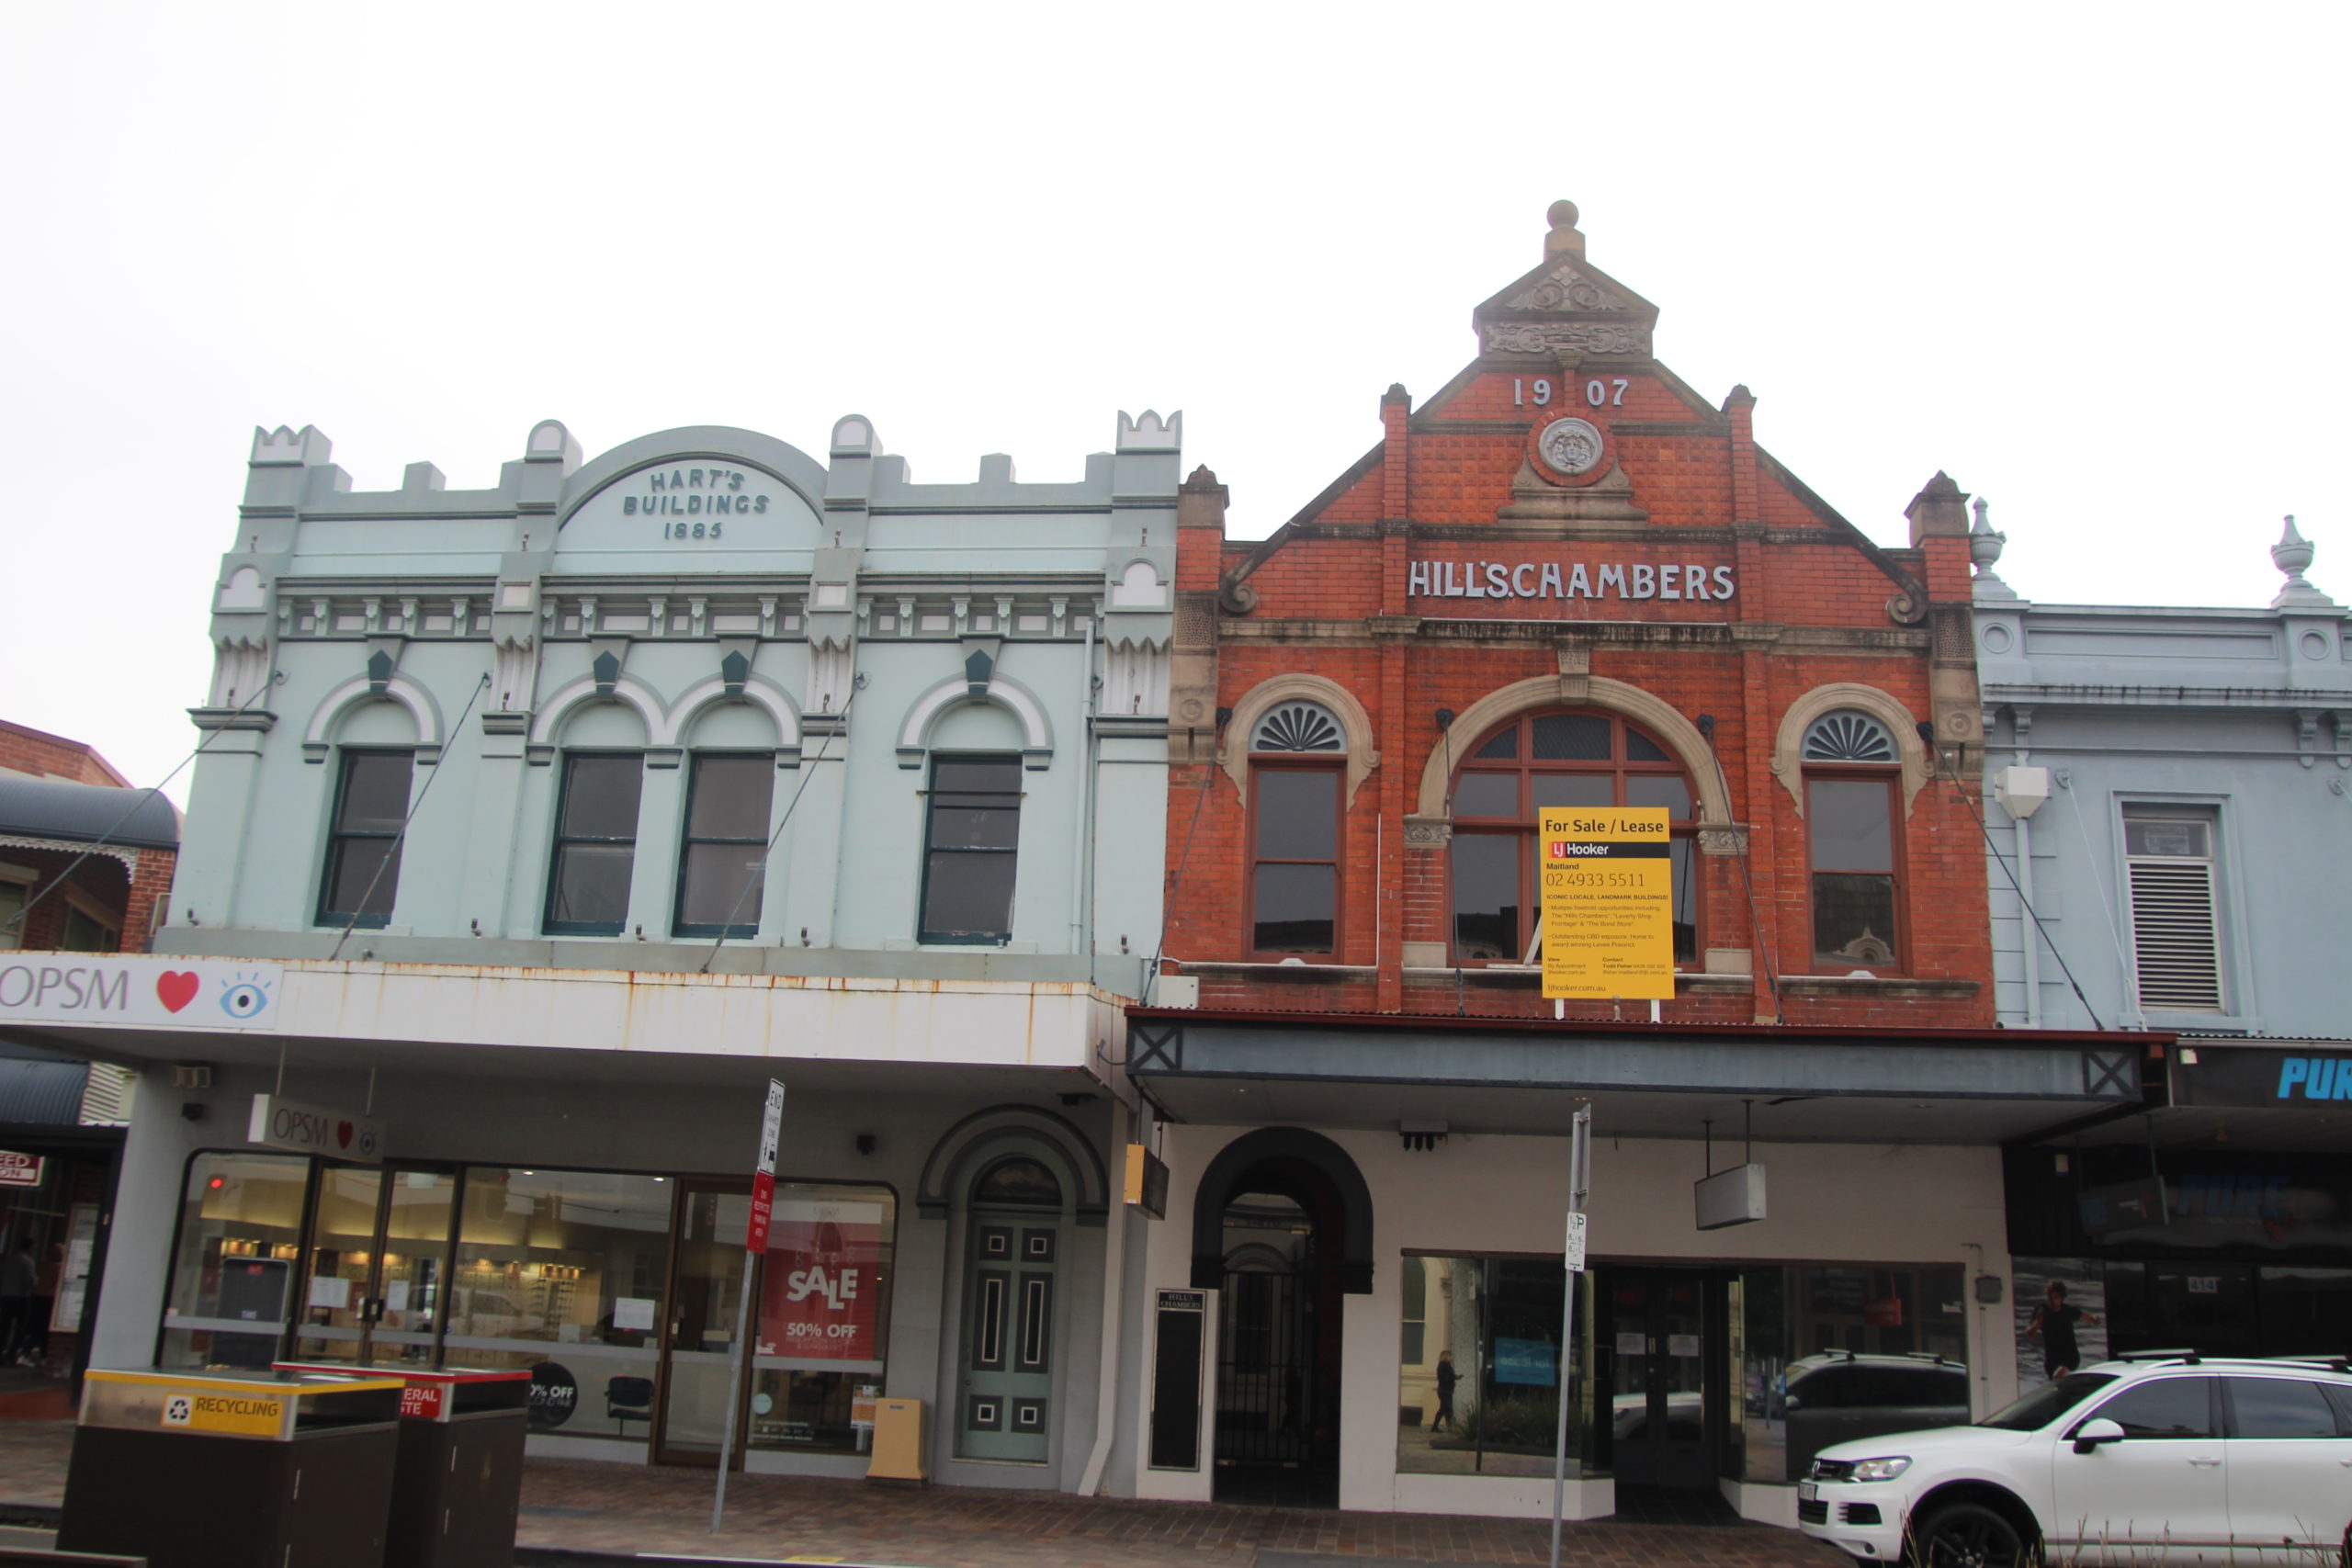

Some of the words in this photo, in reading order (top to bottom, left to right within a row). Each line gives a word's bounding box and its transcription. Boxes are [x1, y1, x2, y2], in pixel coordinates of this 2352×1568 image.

[650, 468, 745, 492] HART'S
[623, 494, 770, 515] BUILDINGS
[664, 521, 722, 540] 1885
[1545, 819, 1568, 832] For
[1573, 818, 1606, 832] Sale
[1621, 819, 1664, 832] Lease
[1566, 842, 1610, 855] Hooker
[1545, 873, 1563, 887] 02
[1566, 873, 1604, 887] 4933
[1609, 873, 1645, 887] 5511
[0, 965, 129, 1010] OPSM
[1548, 984, 1606, 992] ljhooker.com.au
[2278, 1057, 2352, 1100] PUR
[274, 1108, 328, 1147] OPSM
[2177, 1174, 2292, 1218] PURE
[786, 1266, 858, 1309] SALE
[786, 1322, 822, 1337] 50%
[827, 1324, 857, 1338] OFF
[403, 1388, 437, 1402] ERAL
[549, 1385, 574, 1398] OFF
[196, 1396, 278, 1417] RECYCLING
